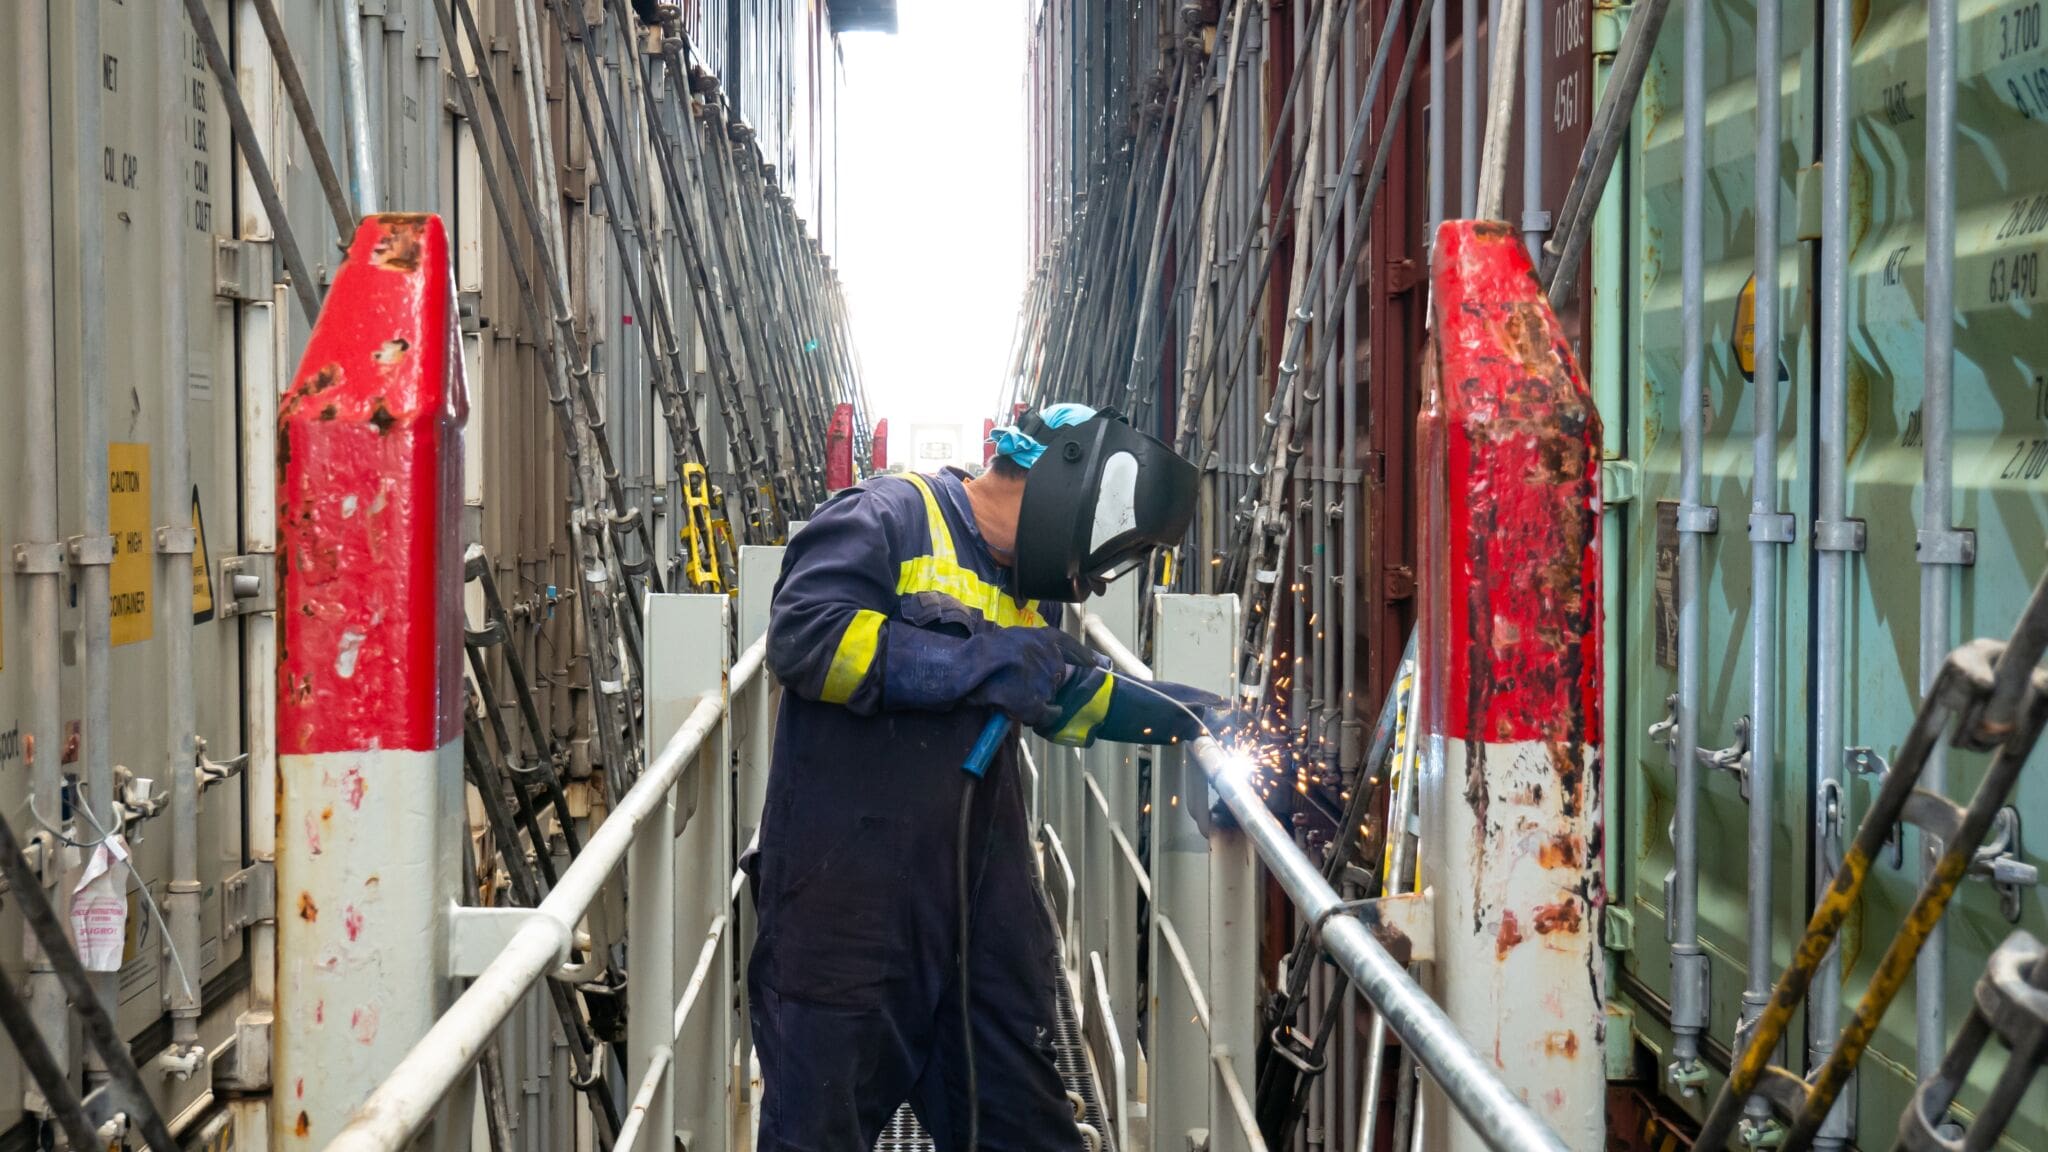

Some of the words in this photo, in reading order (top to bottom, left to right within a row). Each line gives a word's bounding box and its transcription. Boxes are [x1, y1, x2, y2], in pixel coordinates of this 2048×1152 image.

[2000, 2, 2040, 60] 3.700
[103, 53, 118, 93] NET
[1883, 80, 1914, 125] TARE
[1884, 246, 1911, 286] NET
[111, 471, 140, 493] CAUTION
[126, 531, 143, 553] HIGH
